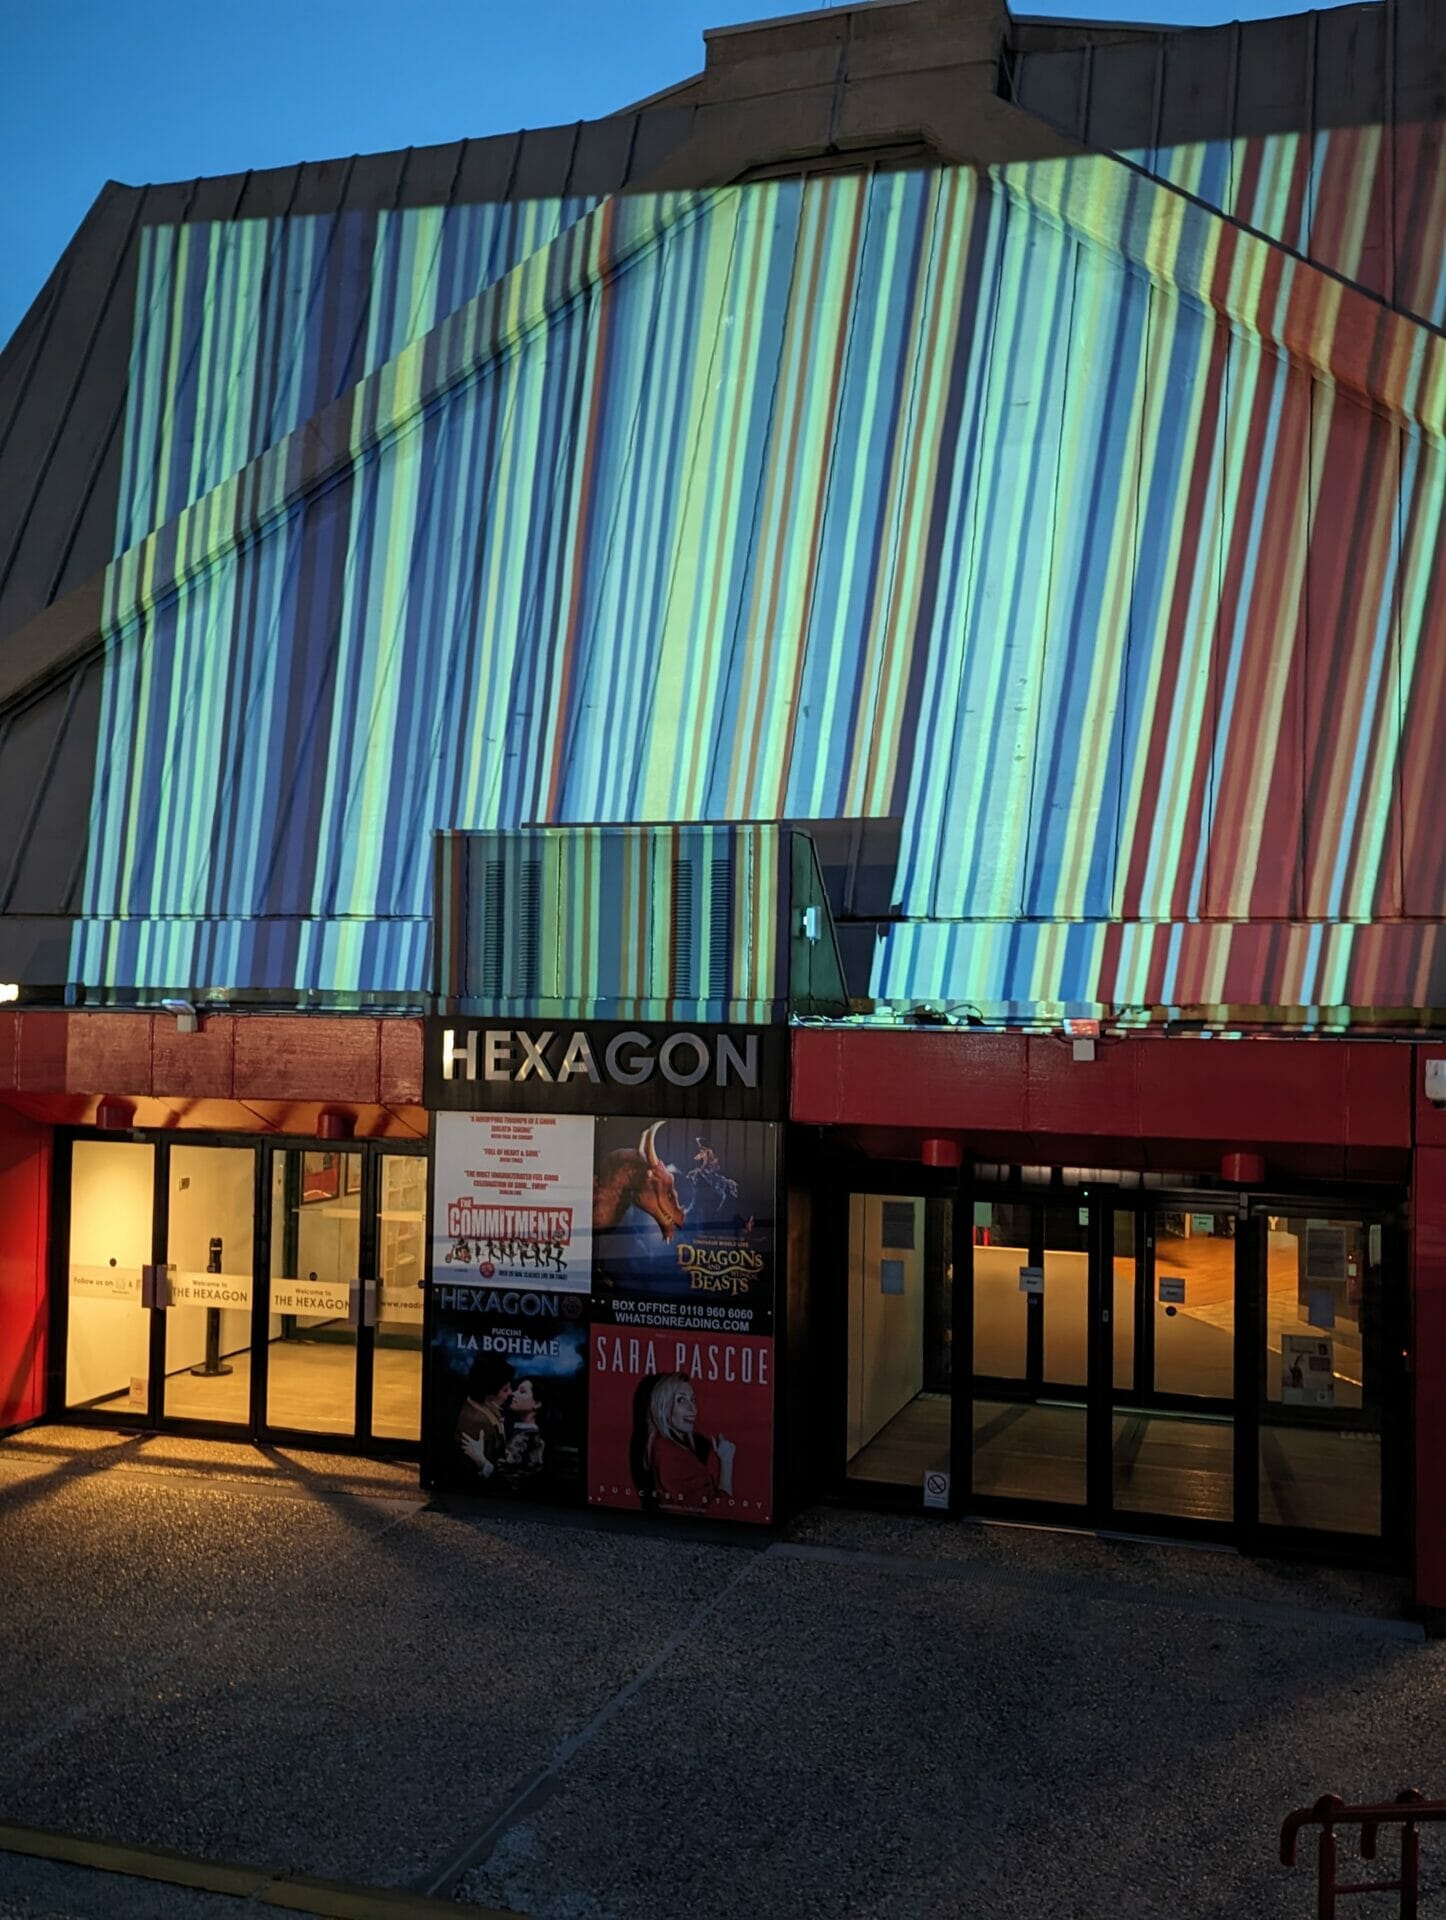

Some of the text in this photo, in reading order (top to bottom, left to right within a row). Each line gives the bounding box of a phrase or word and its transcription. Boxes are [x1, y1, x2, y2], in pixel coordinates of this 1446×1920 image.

[442, 1029, 759, 1088] HEXAGON
[460, 1199, 471, 1208] THE
[449, 1206, 570, 1244] COMMITMENTS
[676, 1243, 763, 1268] DRAGONS
[192, 1280, 220, 1288] Welcome
[295, 1288, 324, 1296] Welcome
[690, 1271, 750, 1296] BEASTS
[173, 1288, 248, 1302] THE HEXAGON
[274, 1295, 293, 1306] THE
[440, 1287, 560, 1318] HEXAGON
[612, 1299, 753, 1320] BOX OFFICE 0118 960 6060
[615, 1312, 750, 1331] WHATSONREADING.COM
[491, 1327, 522, 1337] PUCCINI
[456, 1333, 559, 1356] LA BOHÈME
[597, 1336, 768, 1385] SARA PASCOE
[702, 1495, 762, 1509] STORY
